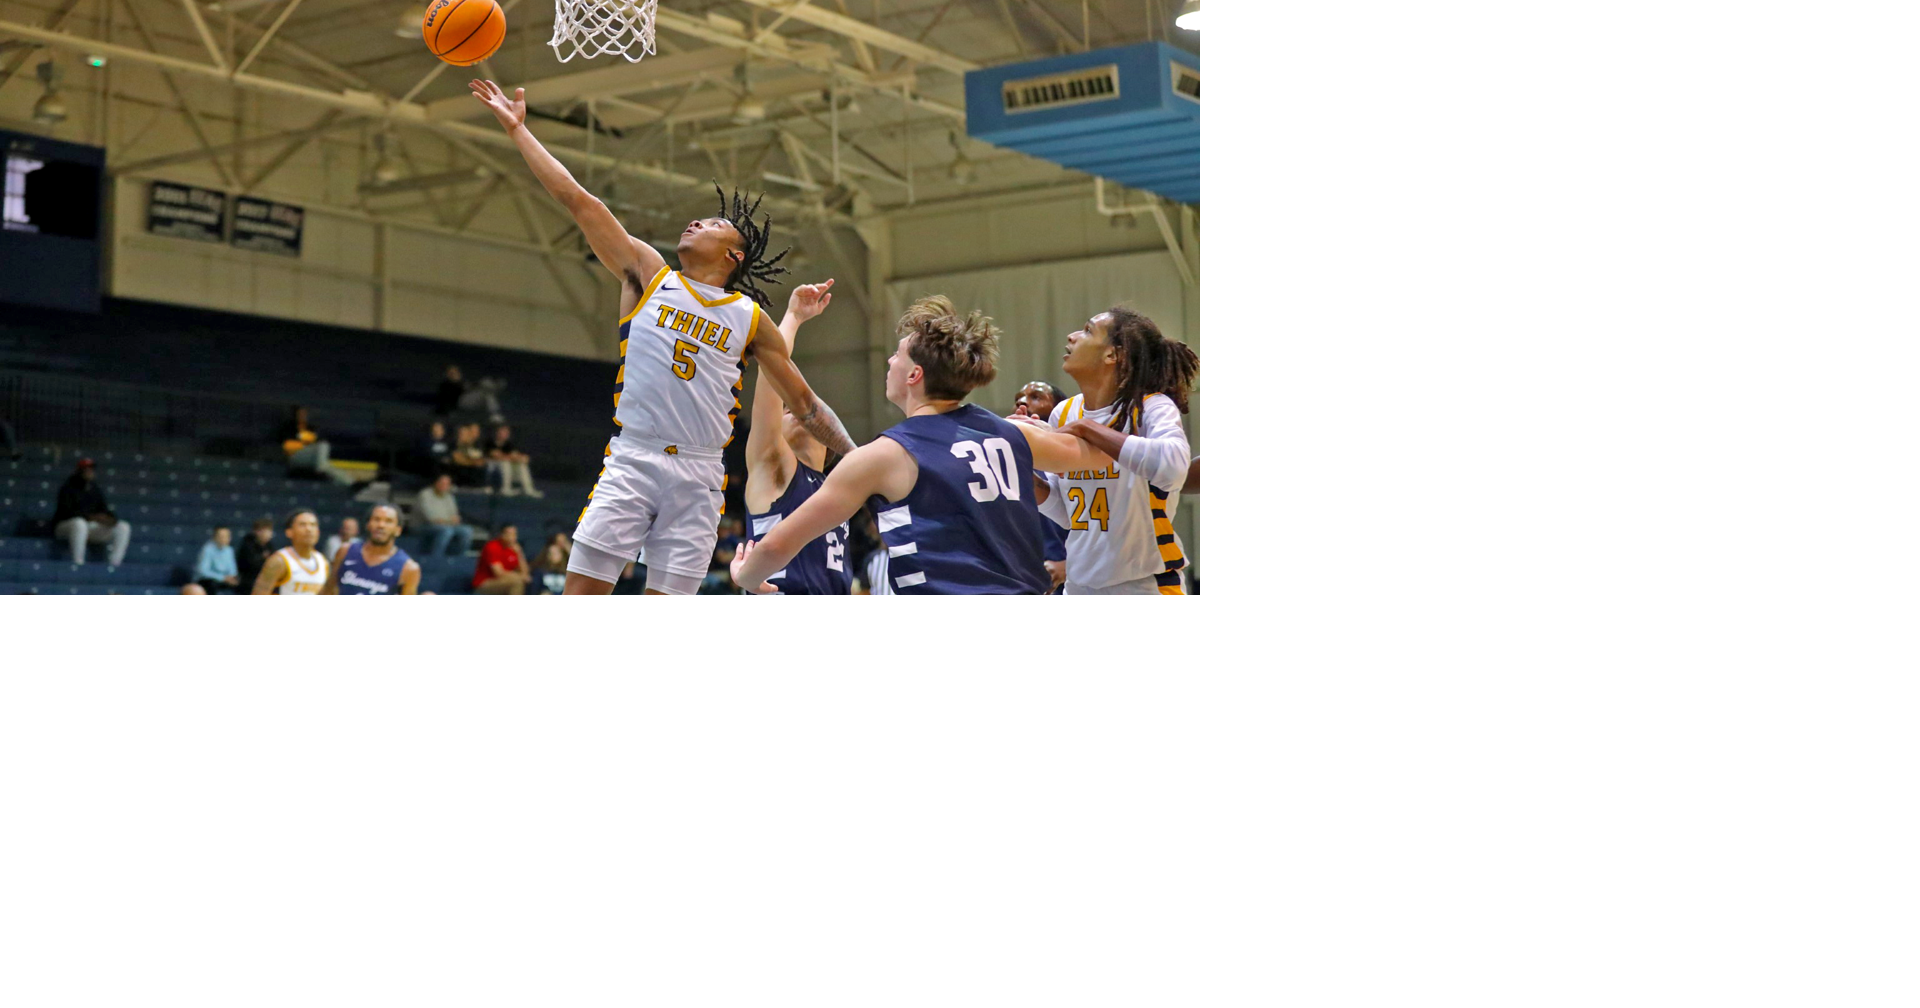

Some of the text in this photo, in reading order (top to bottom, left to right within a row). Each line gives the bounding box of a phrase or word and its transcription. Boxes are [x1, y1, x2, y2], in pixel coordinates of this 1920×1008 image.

[656, 304, 732, 353] THIEL
[671, 339, 700, 381] 5
[950, 437, 1020, 503] 30
[1067, 487, 1110, 532] 24
